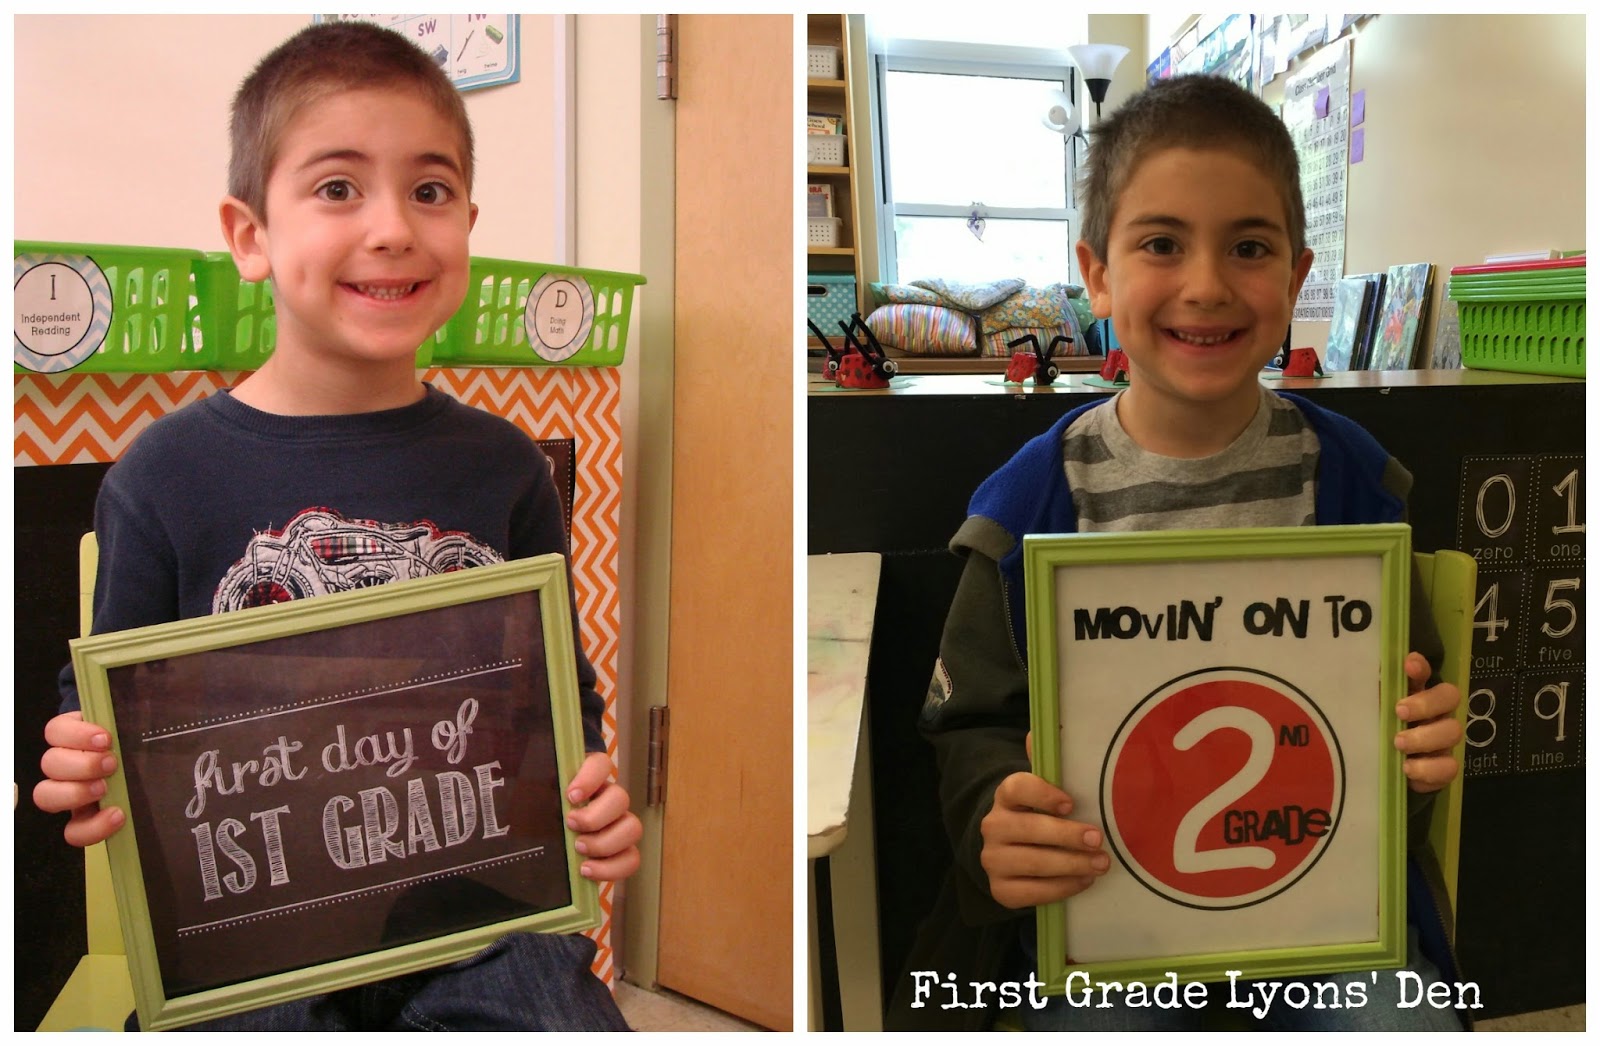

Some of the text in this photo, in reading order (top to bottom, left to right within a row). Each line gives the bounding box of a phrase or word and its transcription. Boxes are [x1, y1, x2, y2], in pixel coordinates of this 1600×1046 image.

[50, 274, 57, 300] I
[555, 289, 568, 308] D
[21, 312, 81, 325] Independent
[31, 326, 71, 337] Reading
[549, 316, 566, 326] Doing
[549, 326, 565, 334] Math
[1475, 473, 1516, 538] 0
[1552, 468, 1586, 535] 1
[1473, 545, 1513, 560] zero
[1550, 542, 1581, 556] one
[1242, 597, 1310, 639] ON
[1323, 595, 1372, 638] TO
[1472, 582, 1510, 642] 4
[1540, 577, 1581, 639] 5
[1538, 646, 1573, 662] five
[1465, 688, 1497, 748] 8
[1534, 681, 1570, 742] 9
[184, 697, 479, 819] first day of
[1531, 751, 1565, 766] nine
[322, 760, 510, 870] GRADE
